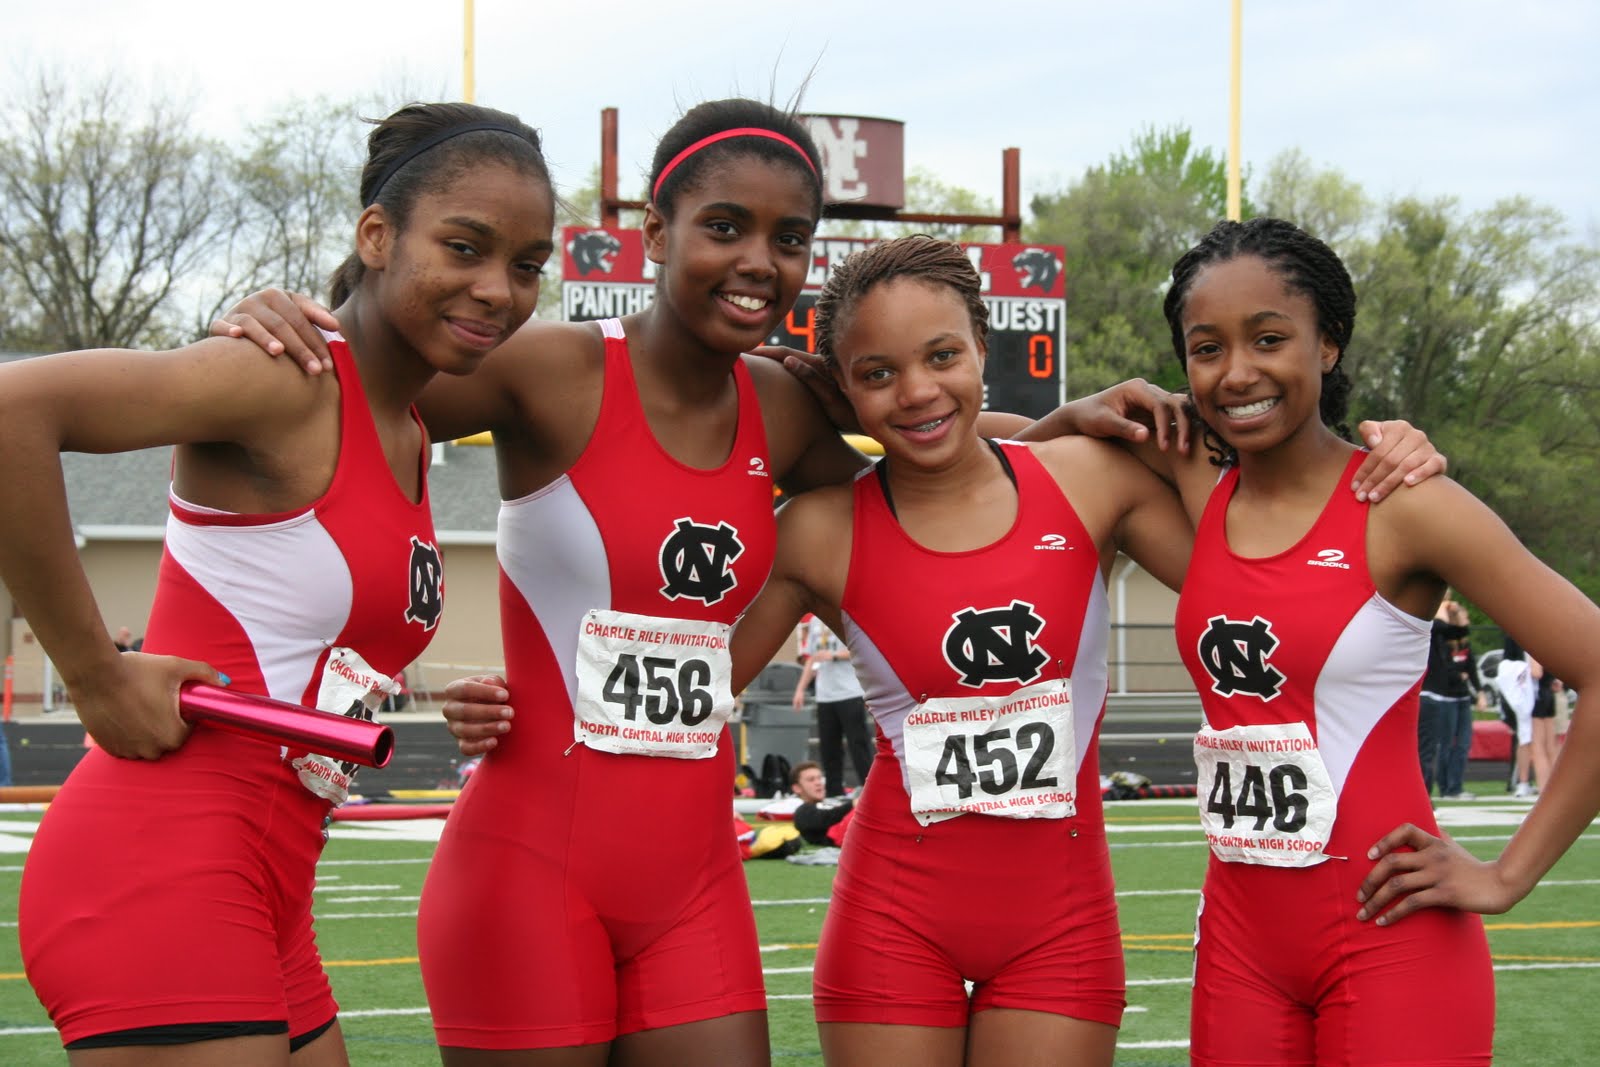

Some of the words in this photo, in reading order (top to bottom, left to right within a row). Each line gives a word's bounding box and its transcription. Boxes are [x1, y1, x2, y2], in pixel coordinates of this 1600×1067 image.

[987, 301, 1060, 332] UEST
[1028, 334, 1054, 379] 0
[1306, 559, 1351, 570] BROOKS
[585, 622, 635, 641] CHARLIE
[638, 631, 669, 645] RILEY
[329, 659, 371, 689] CHARLIE
[602, 653, 714, 726] 456
[908, 711, 957, 726] CHARLIE
[960, 709, 994, 722] RILEY
[998, 692, 1070, 718] INVITATIONAL
[580, 721, 619, 737] NORTH
[622, 727, 663, 743] CENTRAL
[666, 732, 685, 744] HIGH
[1219, 738, 1244, 752] RILEY
[304, 760, 332, 781] NORTH
[935, 722, 1058, 800] 452
[1009, 796, 1035, 807] HIGH
[1207, 761, 1309, 833] 446
[1219, 835, 1256, 848] CENTRAL
[1258, 839, 1284, 850] HIGH
